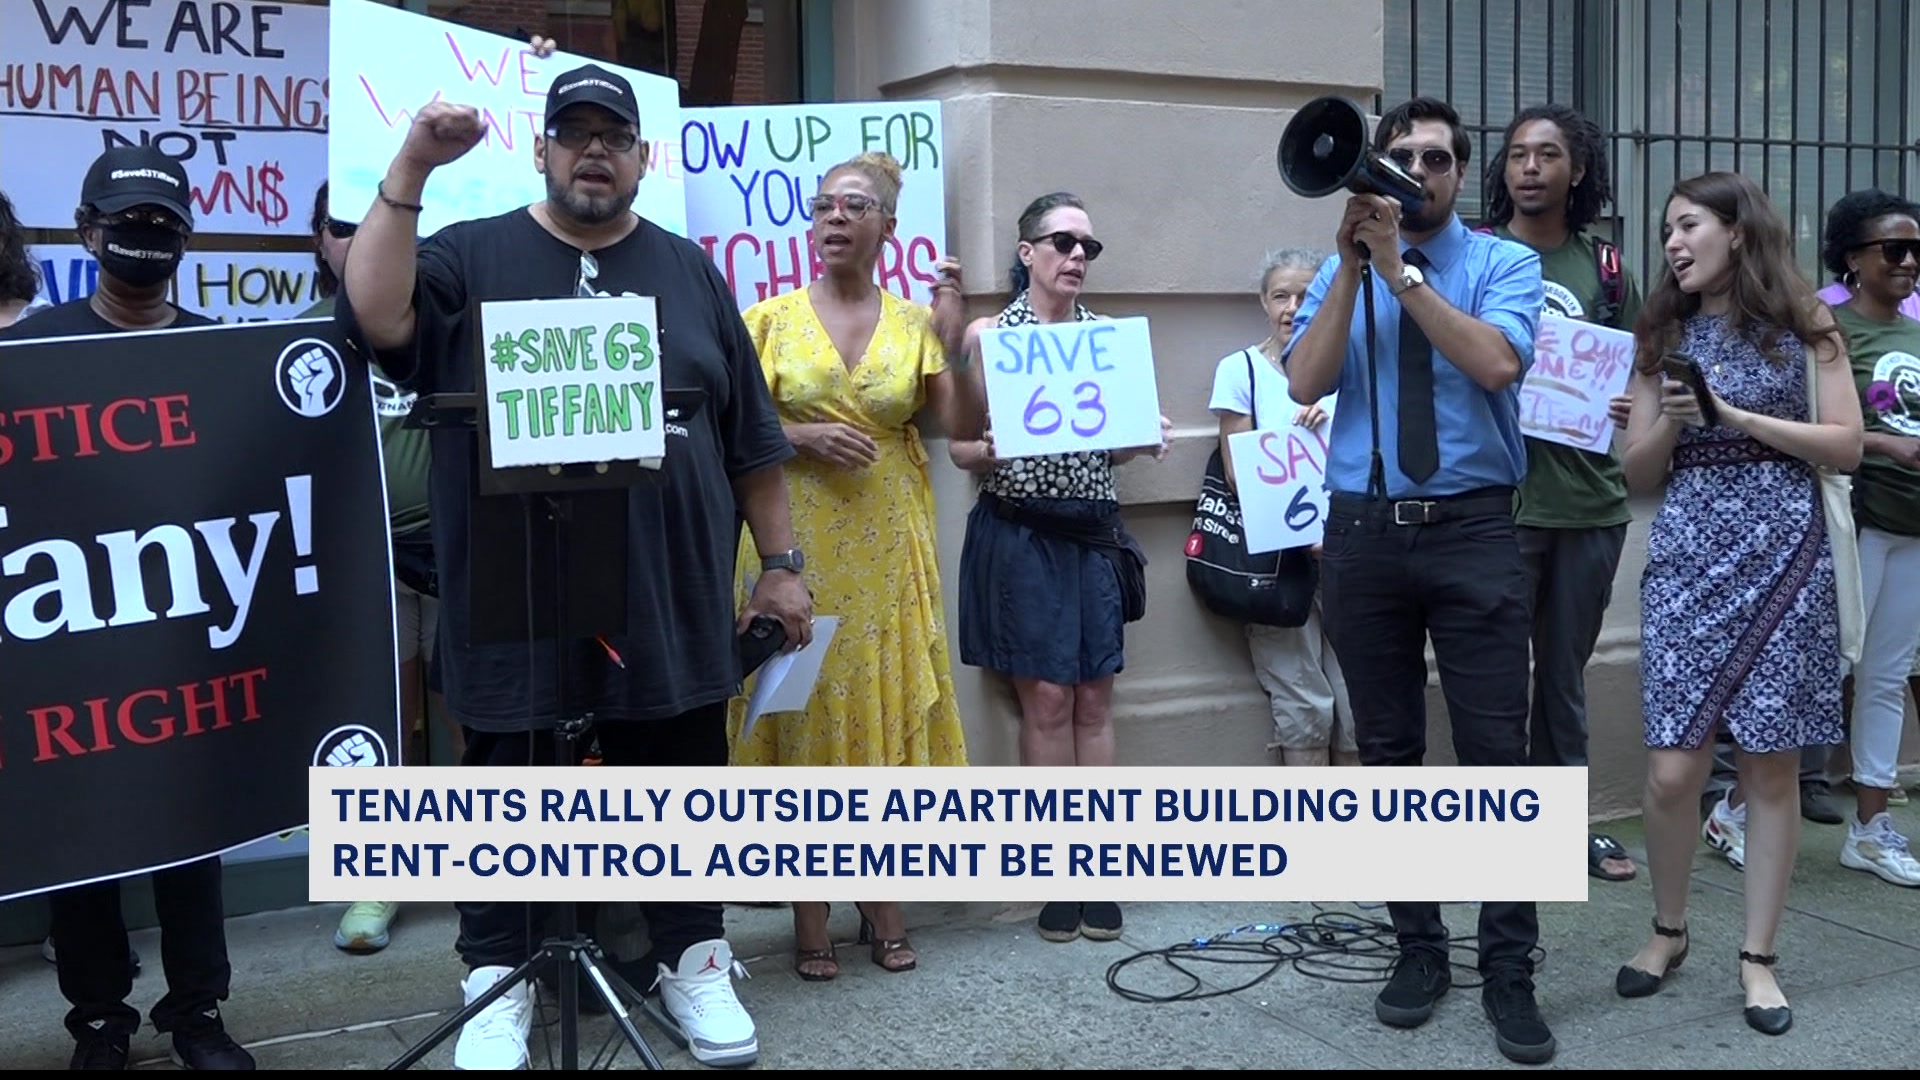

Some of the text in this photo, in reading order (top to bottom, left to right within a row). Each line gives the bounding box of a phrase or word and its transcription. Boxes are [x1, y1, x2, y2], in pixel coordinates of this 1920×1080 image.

[32, 0, 285, 58] WE ARE
[445, 32, 548, 96] WE
[359, 74, 546, 151] WNT
[765, 116, 831, 162] UP
[861, 112, 938, 170] FOR
[102, 129, 236, 165] NOT
[197, 263, 303, 305] HOW
[490, 322, 655, 374] #SAVE 63
[995, 326, 1116, 375] SAVE
[496, 381, 654, 440] TIFFANY
[1023, 381, 1107, 438] 63
[1284, 484, 1329, 532] 6
[0, 475, 319, 650] any!
[1190, 539, 1199, 551] 1
[26, 668, 268, 763] RIGHT
